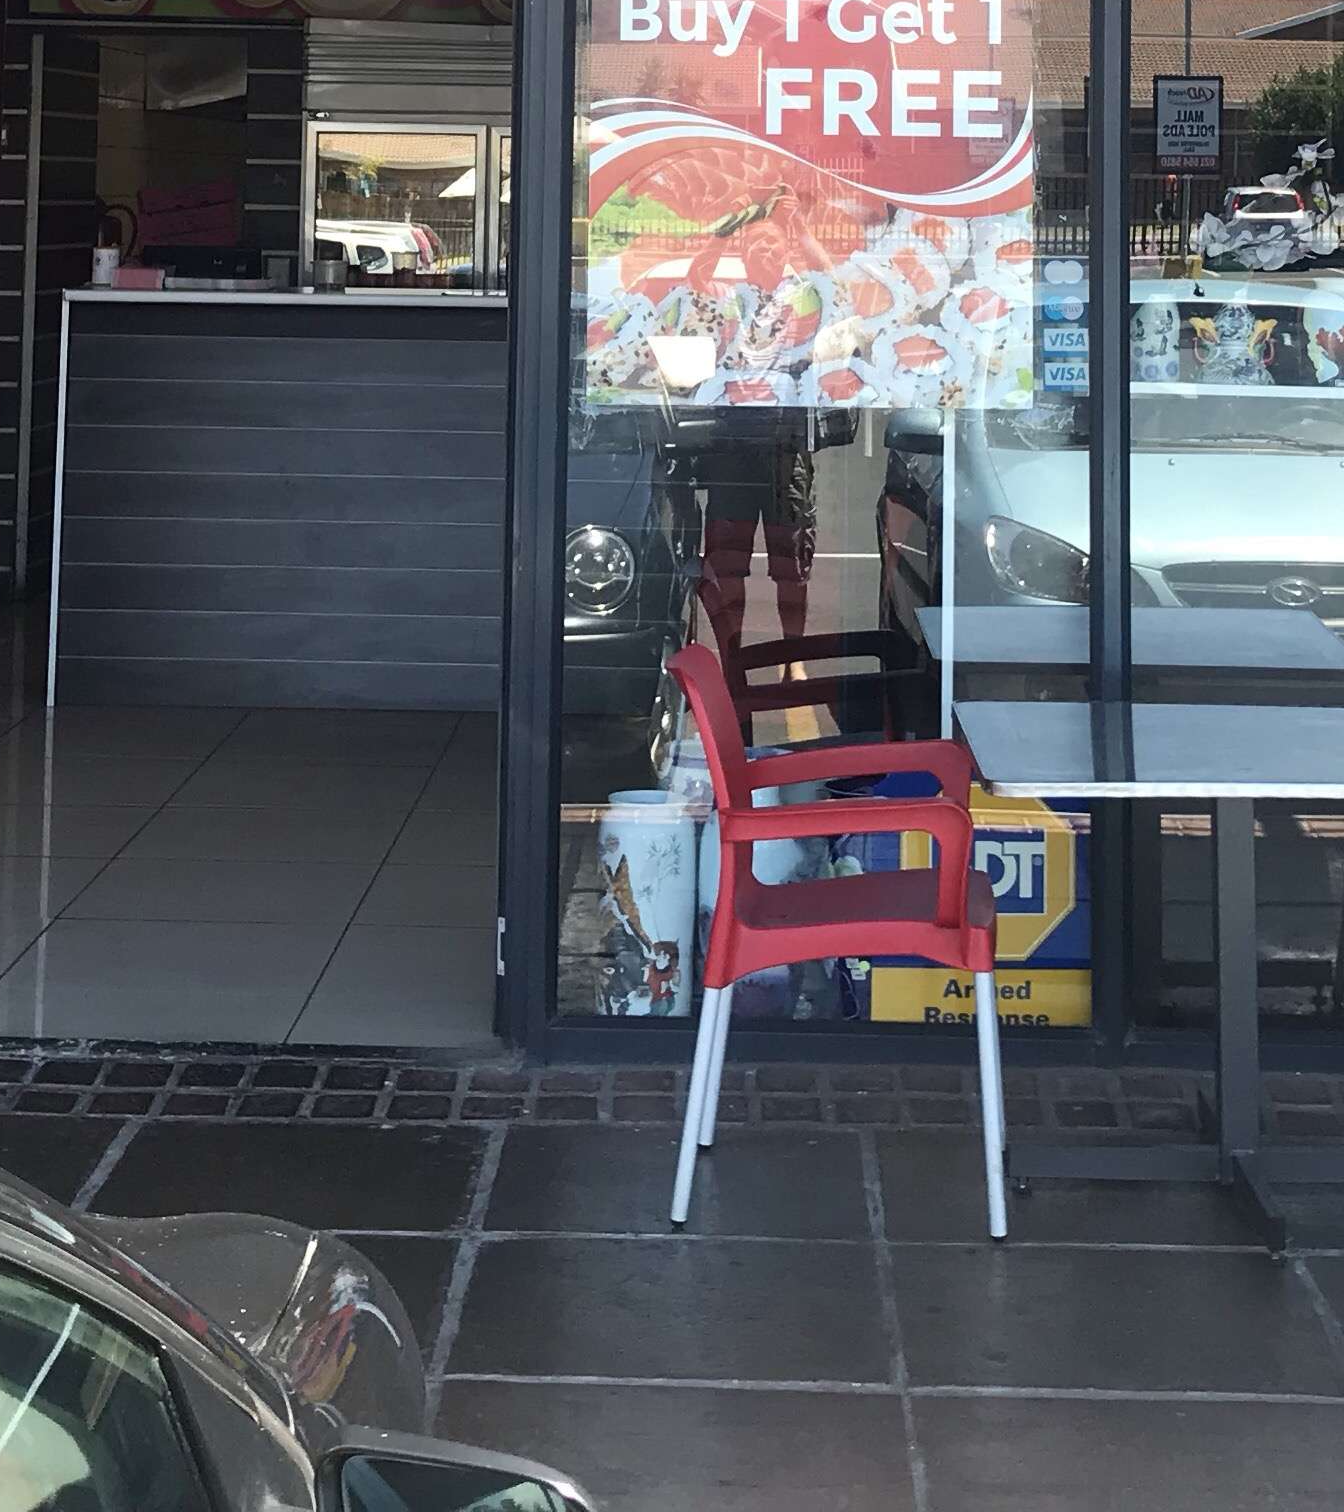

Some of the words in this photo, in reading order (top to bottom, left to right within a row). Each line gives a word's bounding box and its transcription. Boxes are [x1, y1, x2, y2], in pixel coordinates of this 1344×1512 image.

[765, 68, 1003, 138] FREE
[1049, 332, 1086, 347] VISA
[1049, 367, 1087, 382] VISA
[944, 980, 1032, 1001] Ared
